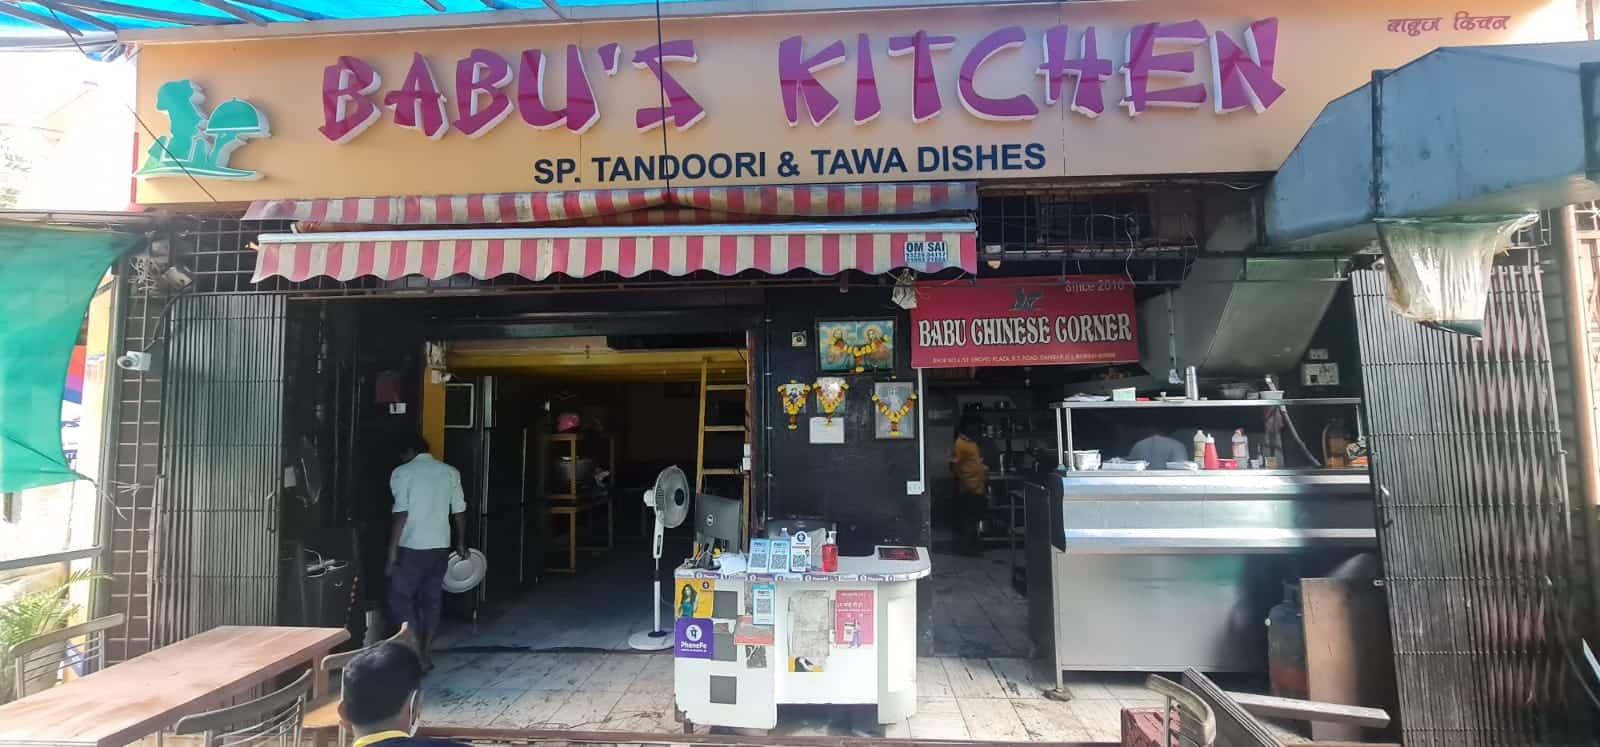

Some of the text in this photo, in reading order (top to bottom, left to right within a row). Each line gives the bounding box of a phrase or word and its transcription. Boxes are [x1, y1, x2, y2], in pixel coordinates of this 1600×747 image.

[1454, 11, 1511, 31] किचन
[318, 17, 1286, 145] BABU'S KITCHEN
[534, 143, 1047, 184] SP. TANDOORI & TAWA DISHES
[906, 242, 945, 252] OM SAI
[1065, 279, 1125, 292] Since 2010
[918, 313, 1132, 348] BABU CHINESE CORNER
